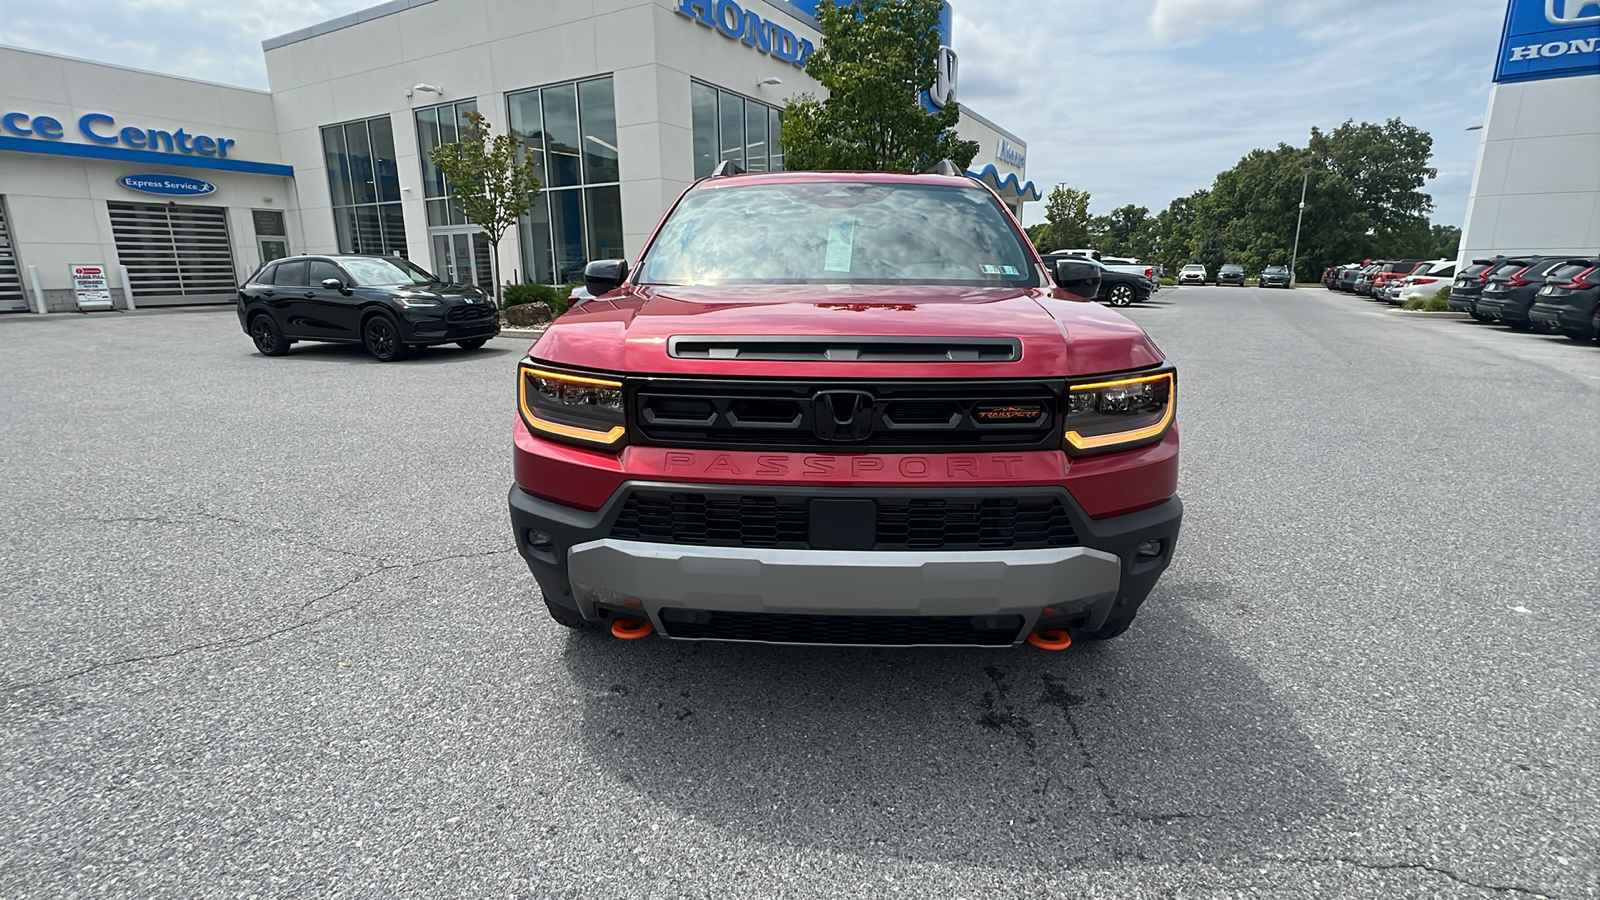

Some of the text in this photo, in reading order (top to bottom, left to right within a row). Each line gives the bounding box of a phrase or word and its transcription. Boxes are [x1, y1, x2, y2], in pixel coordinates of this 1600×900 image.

[1509, 38, 1600, 62] HON
[0, 112, 235, 158] ce Center
[125, 178, 198, 190] Express Service
[663, 451, 1024, 478] PASSPORT
